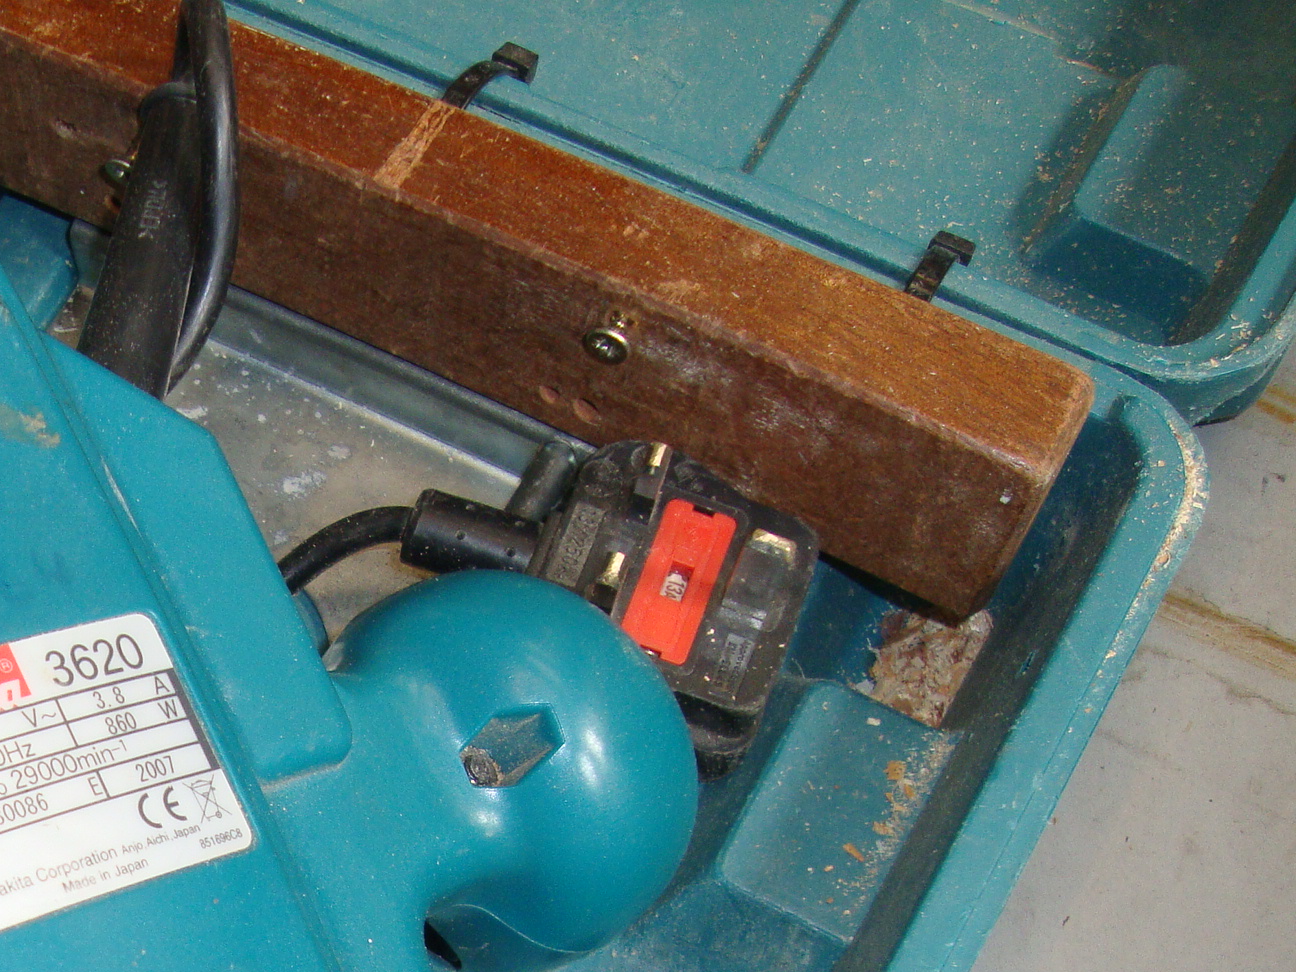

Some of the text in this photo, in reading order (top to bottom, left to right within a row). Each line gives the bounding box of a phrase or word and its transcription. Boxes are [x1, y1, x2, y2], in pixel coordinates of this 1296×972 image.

[45, 633, 144, 687] 3620
[93, 676, 170, 709] 3.8 A
[105, 699, 178, 735] 860 W
[87, 776, 103, 797] E
[135, 755, 175, 783] 2007
[35, 847, 119, 883] Corporation
[62, 857, 150, 894] Made in Japan
